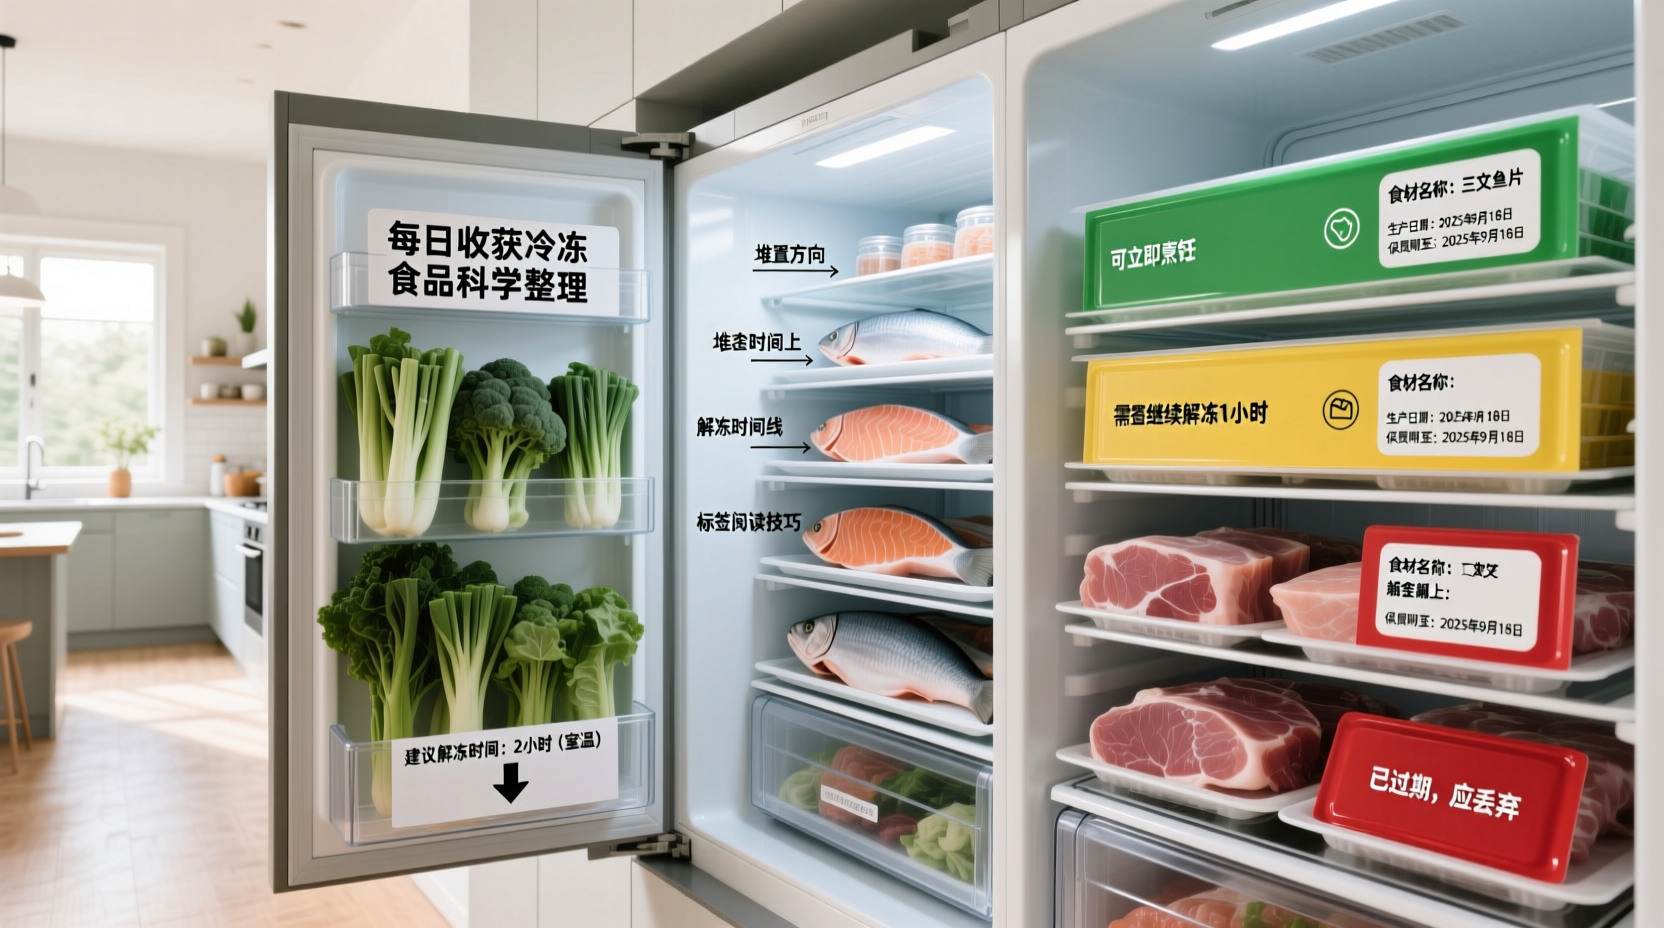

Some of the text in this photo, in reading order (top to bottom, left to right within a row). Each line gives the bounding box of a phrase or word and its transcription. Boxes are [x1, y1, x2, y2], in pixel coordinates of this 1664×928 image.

[388, 220, 588, 264] 每日收获冷冻
[753, 244, 825, 265] 堆置方向
[388, 261, 588, 303] 食品科学整理
[1387, 373, 1455, 392] 食材名称：
[696, 416, 784, 437] 解冻时间线
[696, 511, 802, 532] 标签阅读技巧
[1369, 765, 1522, 822] 已过期，应丢弃
